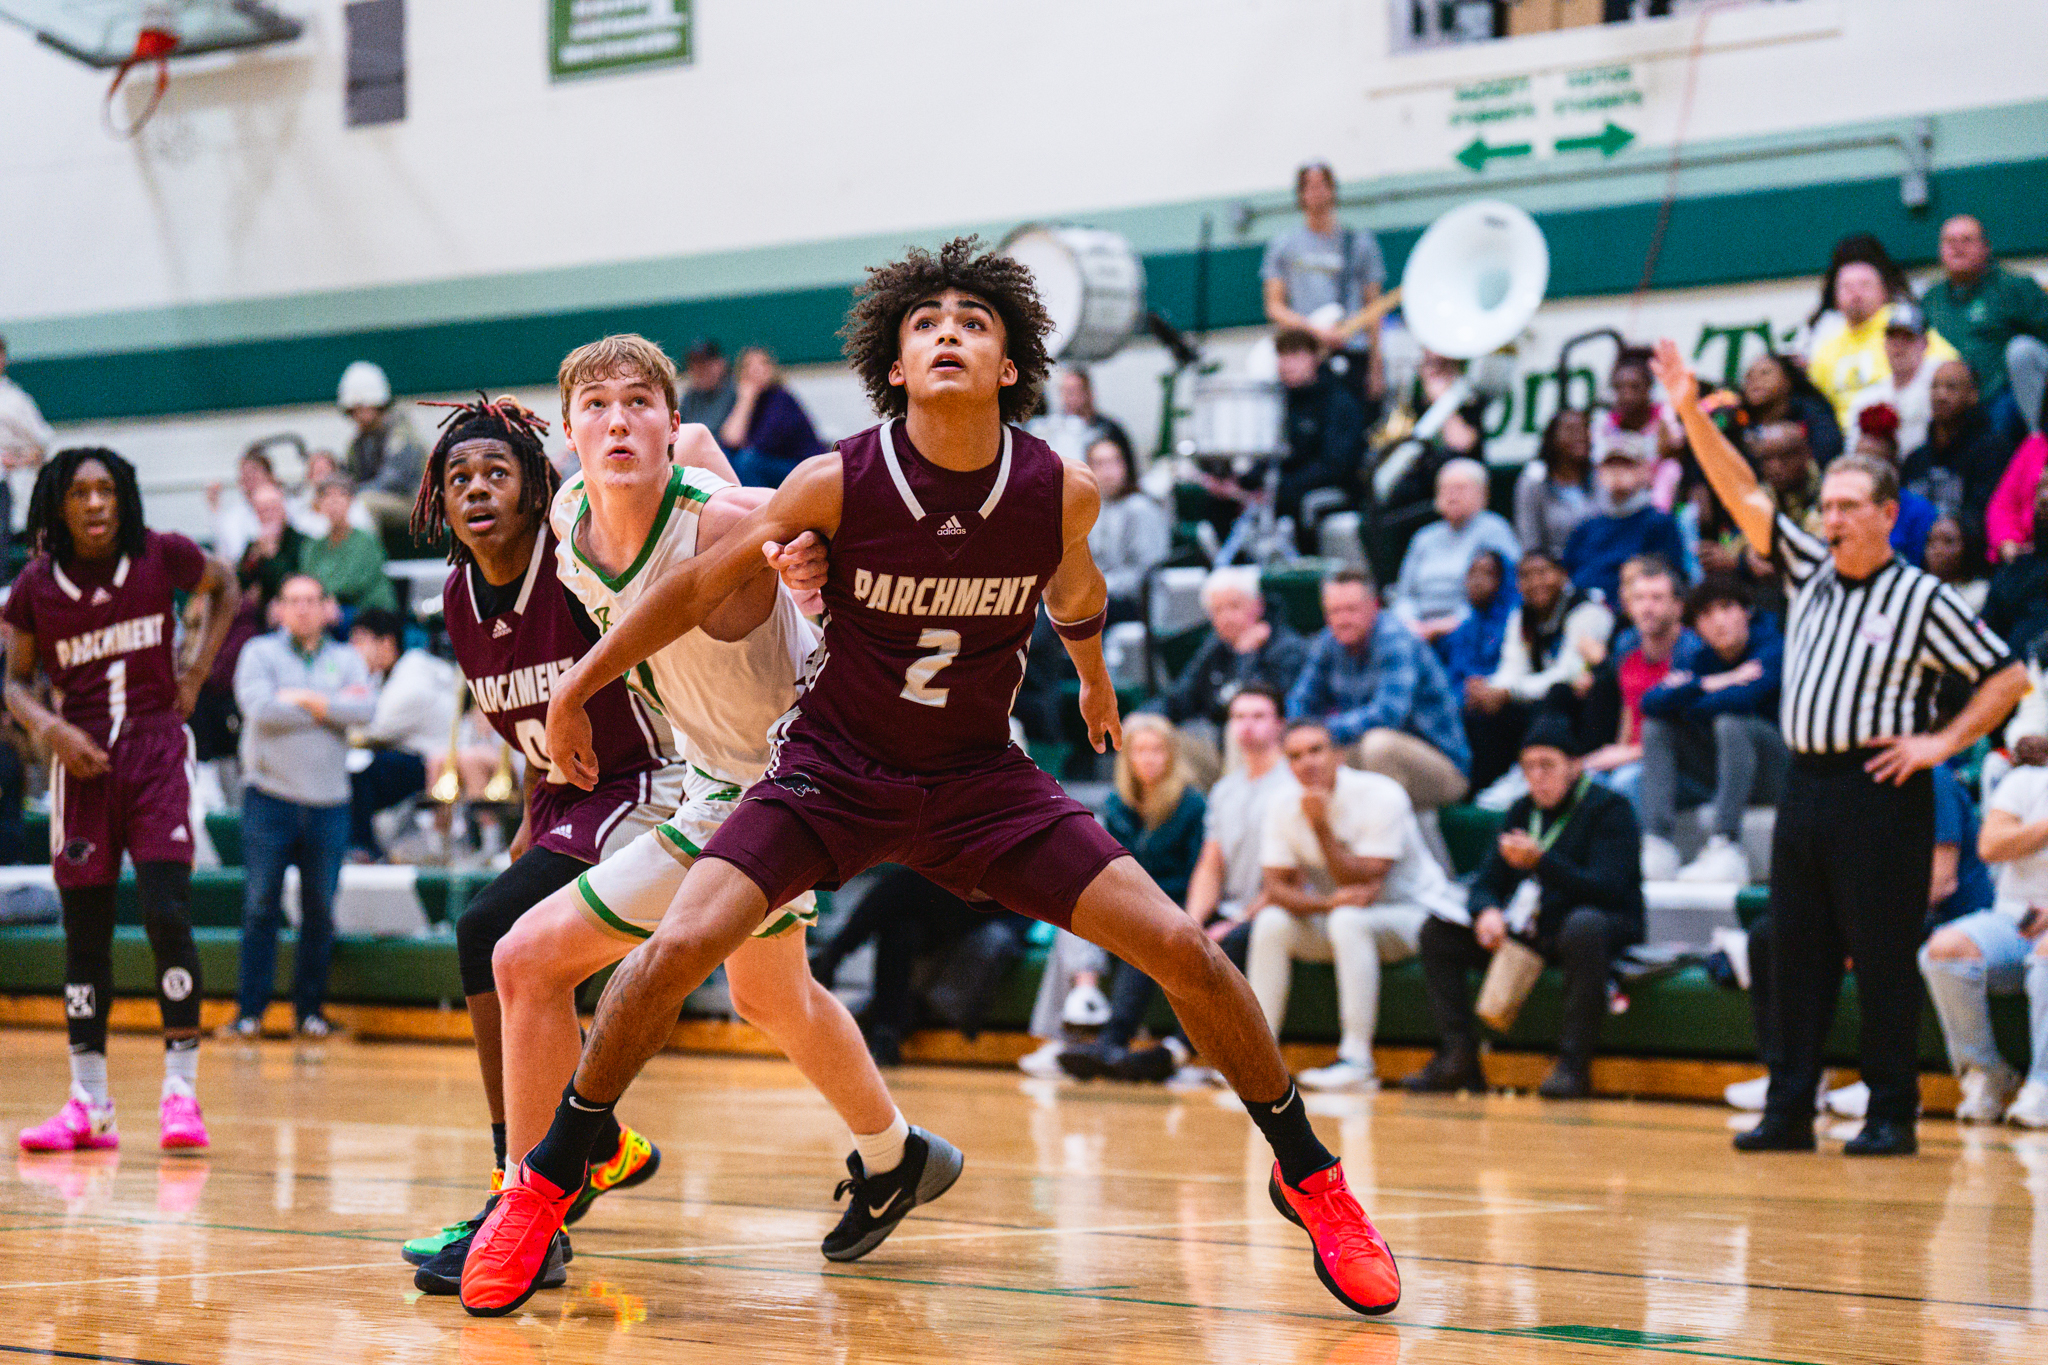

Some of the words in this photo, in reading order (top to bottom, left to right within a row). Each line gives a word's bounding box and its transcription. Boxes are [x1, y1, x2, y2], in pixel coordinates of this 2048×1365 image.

[936, 527, 967, 536] adidas
[854, 567, 1039, 617] PARCHMENT
[55, 612, 166, 670] PARCHMENT
[899, 627, 962, 709] 2
[105, 659, 128, 749] 1
